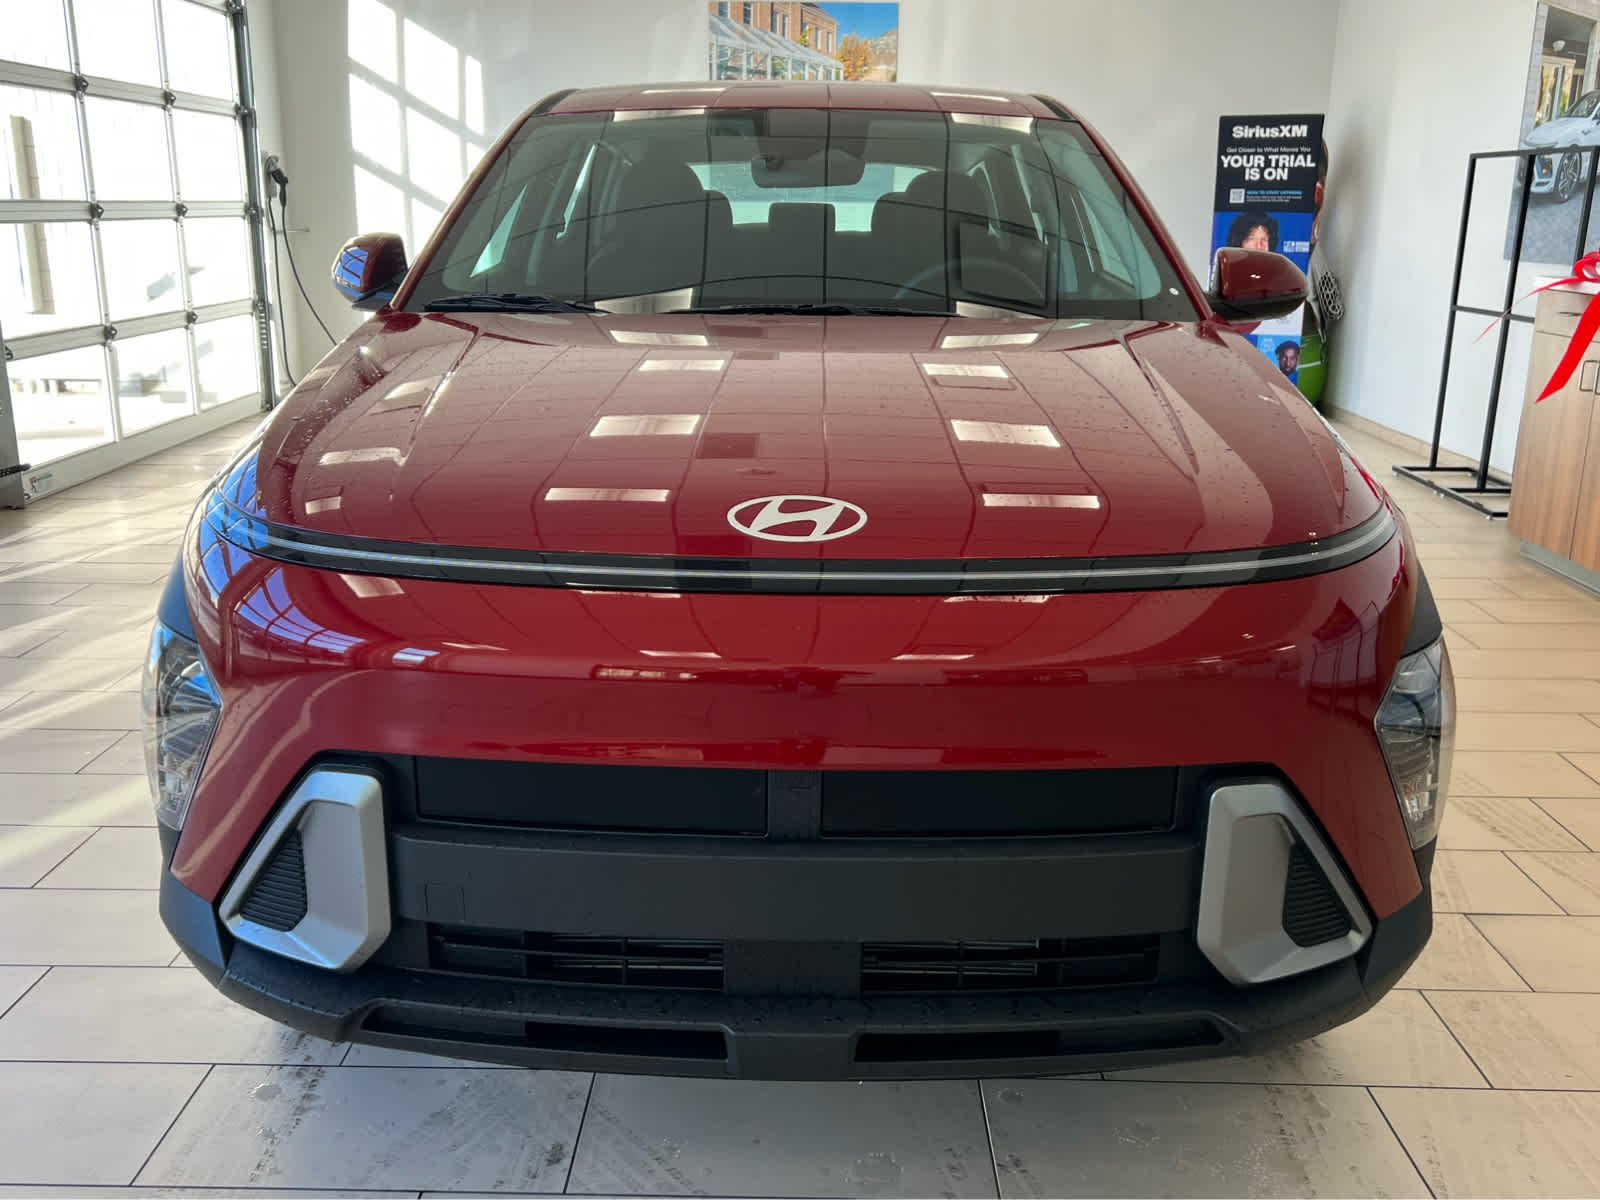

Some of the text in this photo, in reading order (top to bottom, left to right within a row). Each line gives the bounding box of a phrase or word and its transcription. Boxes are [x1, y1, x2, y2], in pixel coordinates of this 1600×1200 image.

[1232, 125, 1308, 138] SiriusXM
[1221, 154, 1316, 168] YOUR TRIAL
[1245, 168, 1288, 180] IS ON
